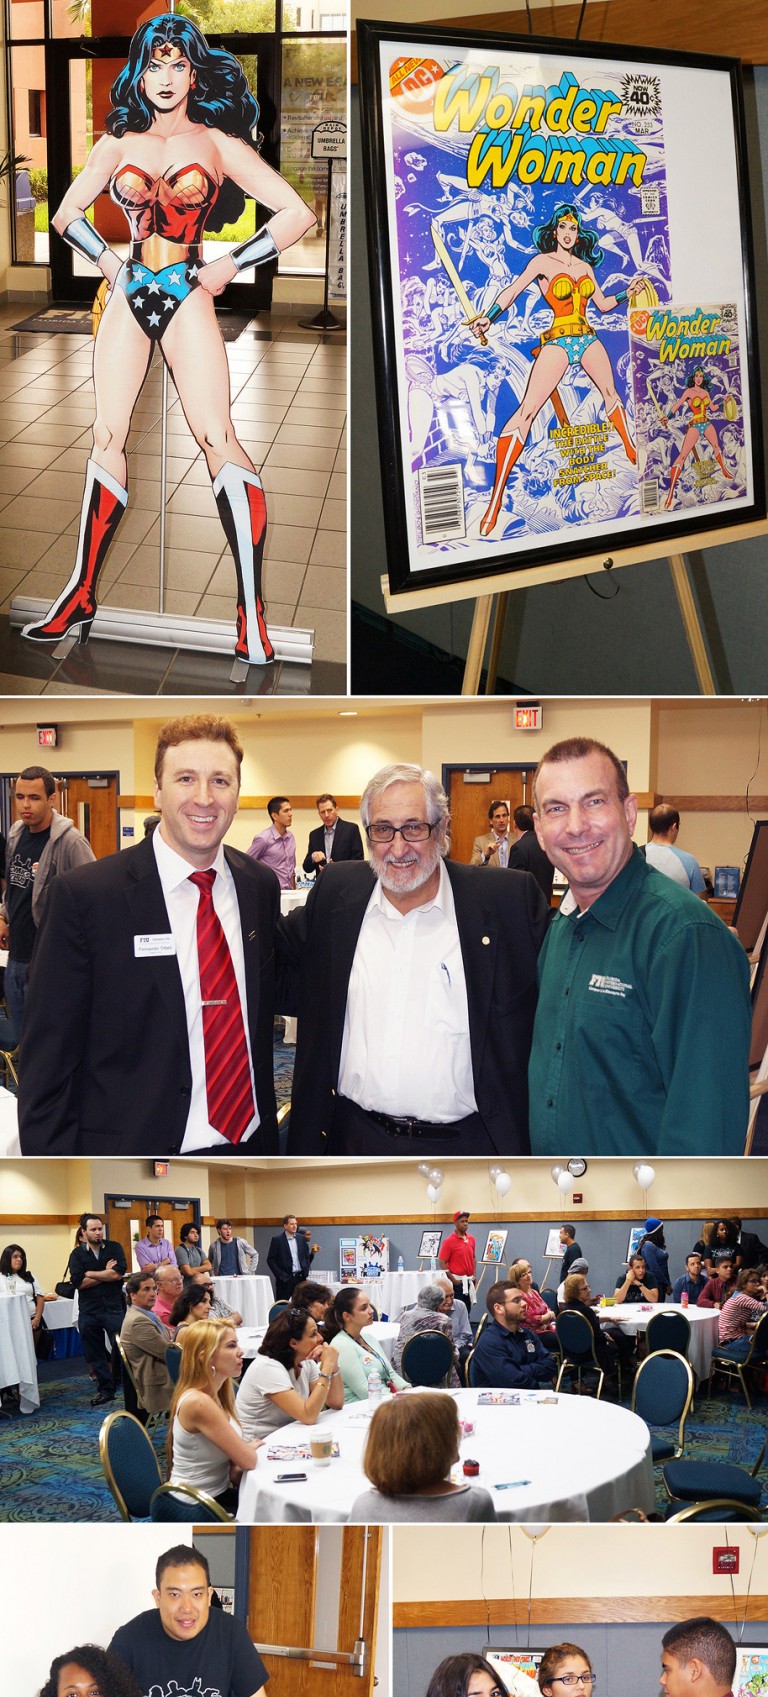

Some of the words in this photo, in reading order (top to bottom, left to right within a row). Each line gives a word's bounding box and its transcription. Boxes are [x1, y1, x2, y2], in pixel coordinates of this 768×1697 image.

[434, 67, 622, 134] Wonder
[467, 128, 647, 188] Woman
[646, 309, 720, 341] Wonder
[660, 336, 731, 363] Woman
[555, 437, 574, 448] THE
[575, 434, 608, 447] BATTLE
[560, 448, 586, 458] WITH
[587, 443, 605, 453] THE
[558, 462, 608, 477] SNATCHER
[569, 455, 595, 466] BODY
[553, 476, 583, 487] FROM
[584, 469, 616, 482] SPACE!
[516, 709, 539, 727] EXIT
[38, 731, 53, 745] EXIT
